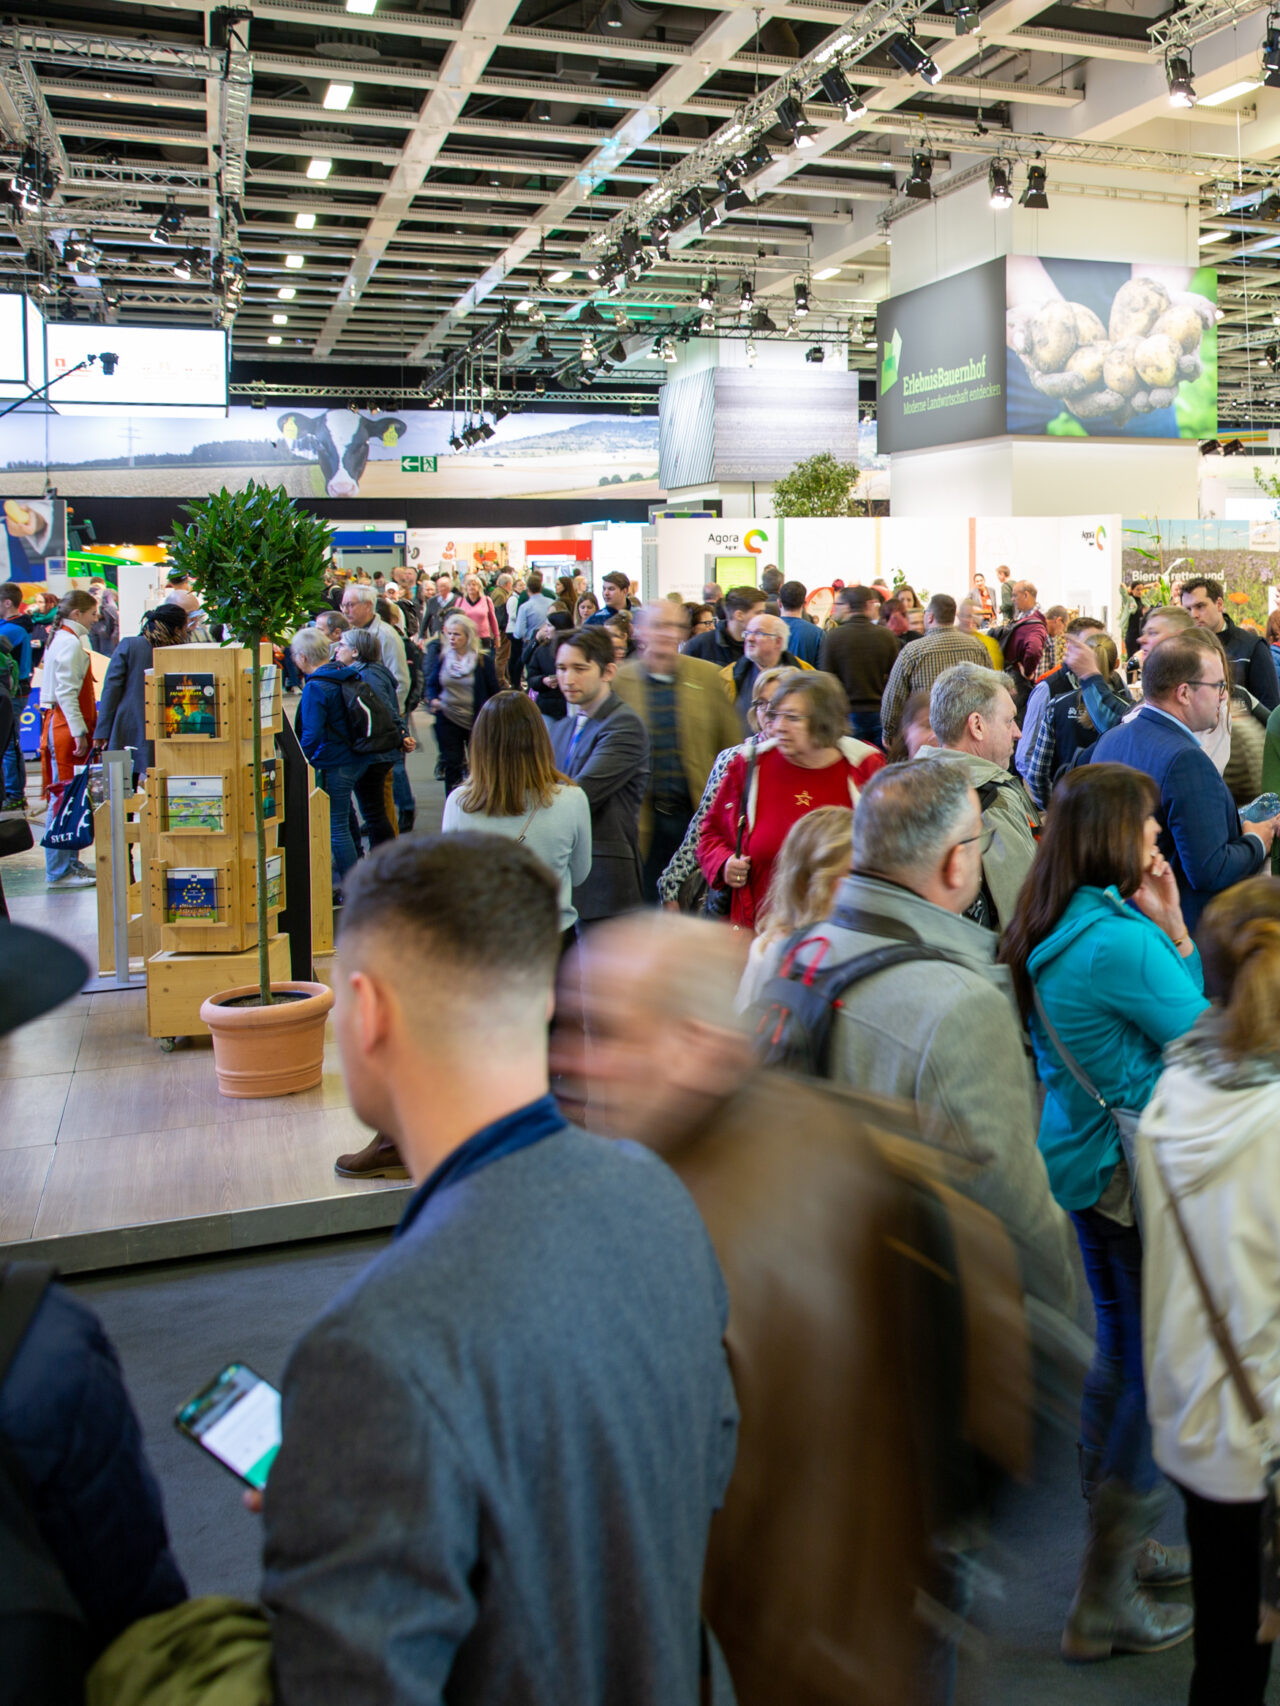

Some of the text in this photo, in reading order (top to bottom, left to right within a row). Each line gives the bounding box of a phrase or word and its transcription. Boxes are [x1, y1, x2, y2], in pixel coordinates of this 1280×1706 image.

[903, 354, 986, 397] ErlebnisBauernhof
[903, 397, 927, 416] Moderne
[927, 388, 969, 411] Landwirtschaft
[708, 532, 739, 545] Agora
[51, 832, 74, 843] SYLT
